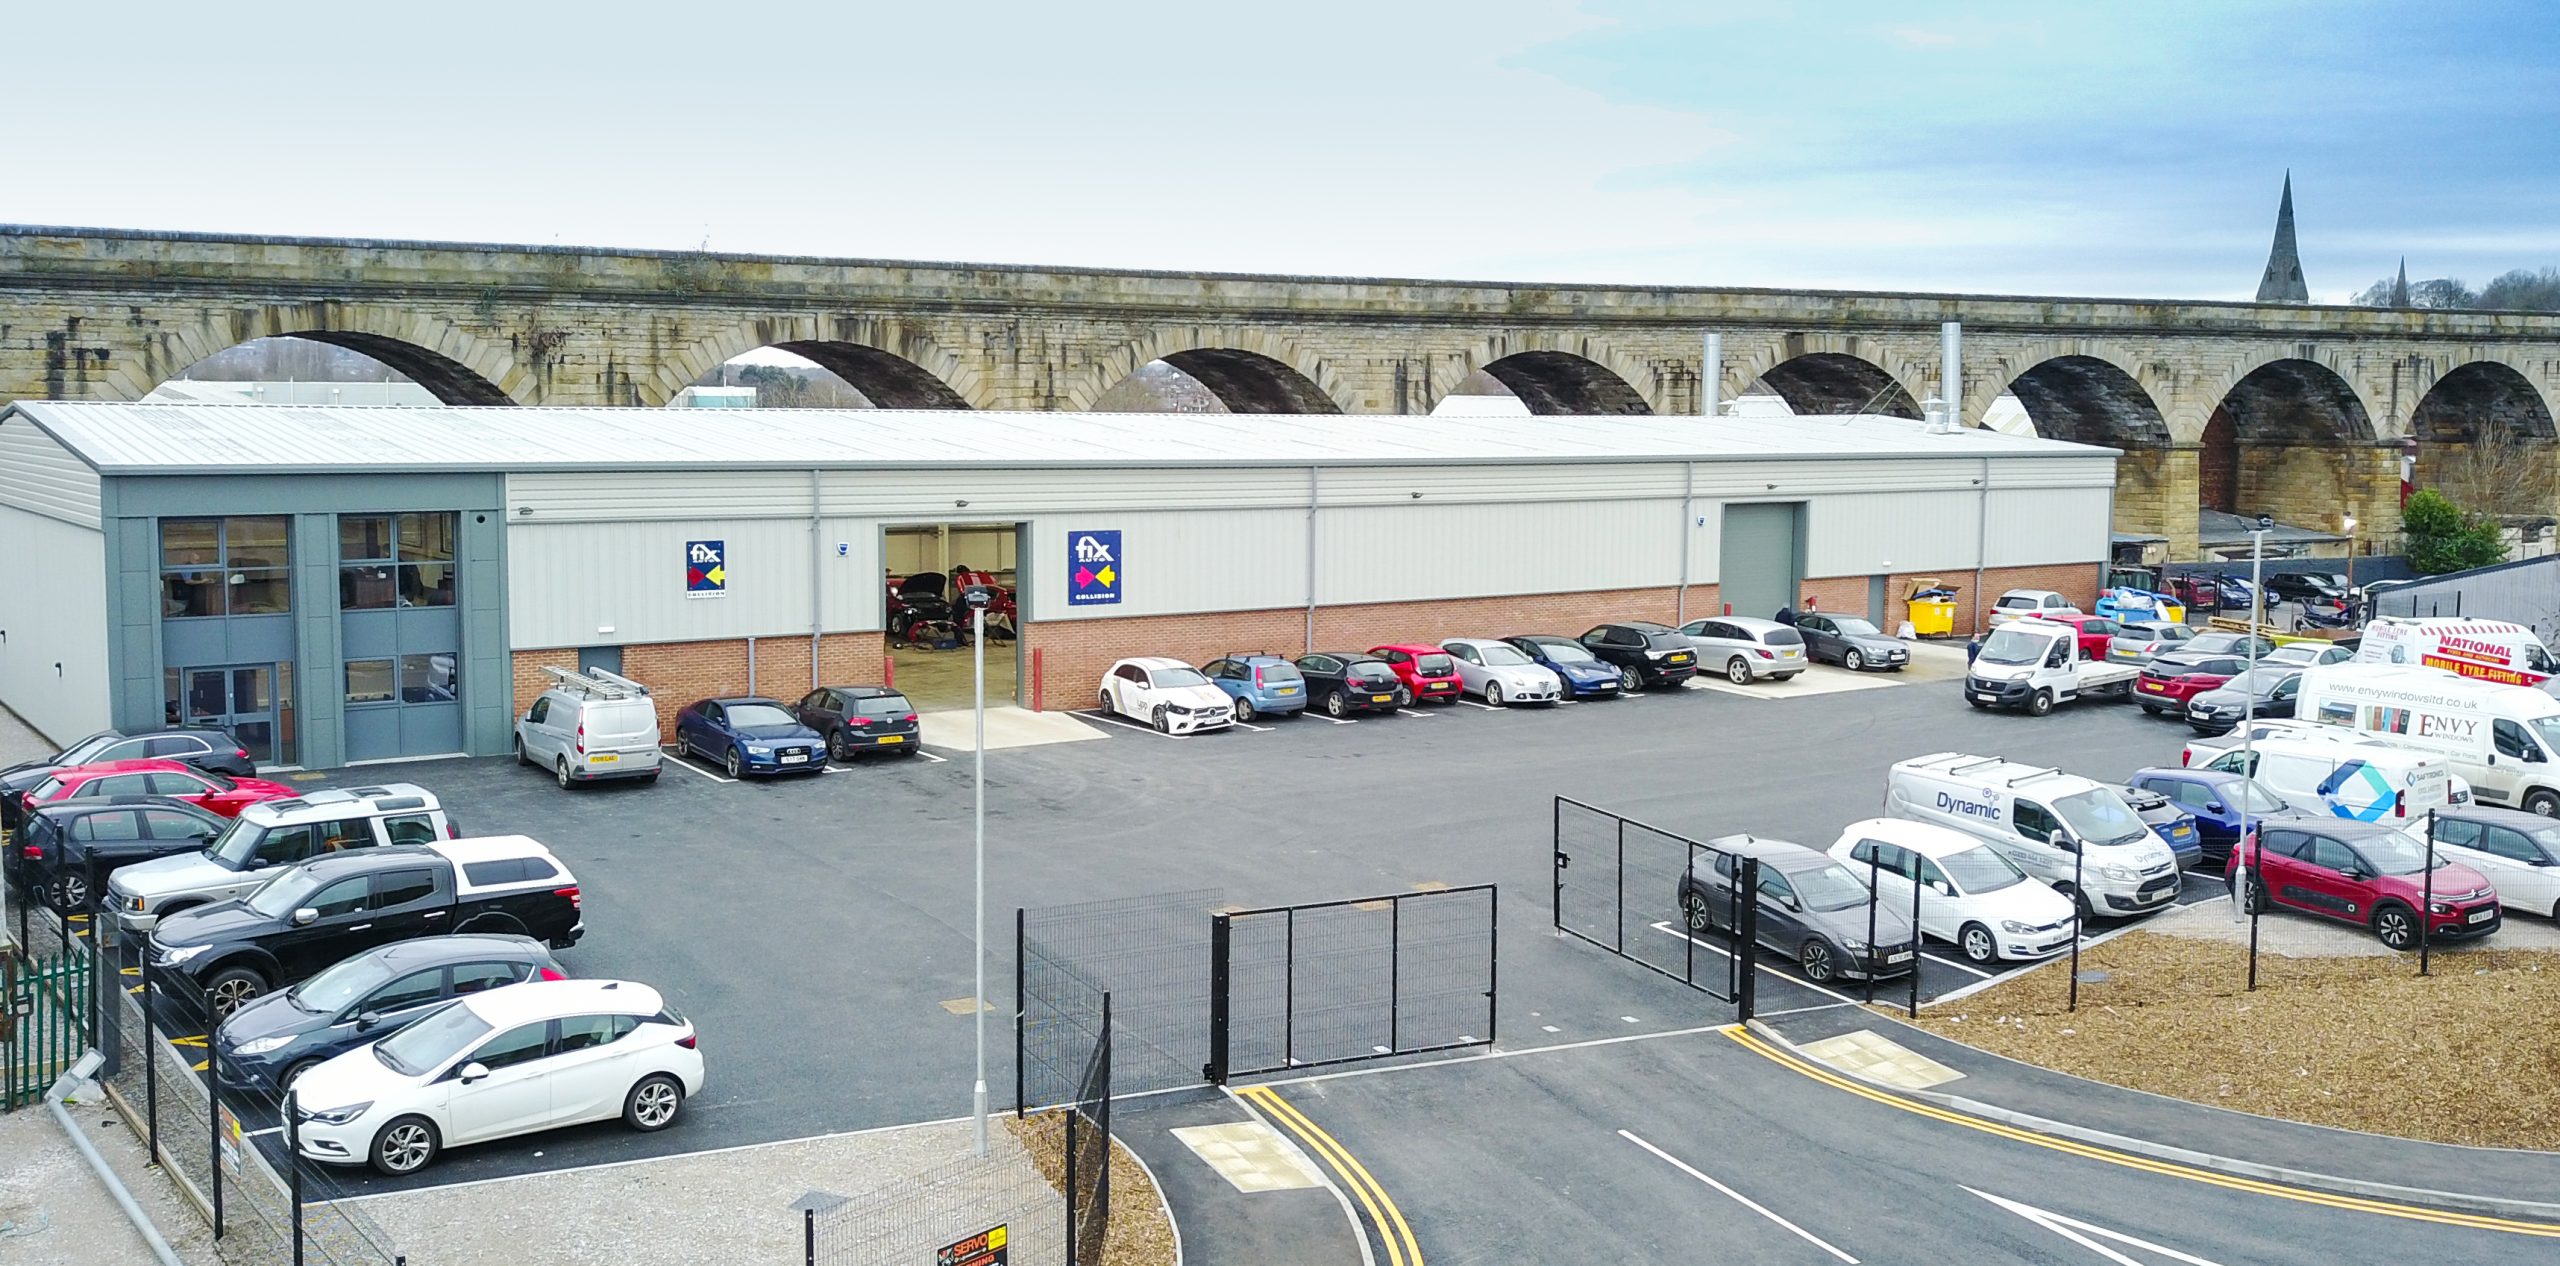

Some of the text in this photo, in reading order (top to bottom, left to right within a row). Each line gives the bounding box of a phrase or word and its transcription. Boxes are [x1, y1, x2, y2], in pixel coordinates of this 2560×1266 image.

[690, 544, 721, 562] fix
[1075, 536, 1115, 561] fix
[2440, 635, 2512, 658] NATIONAL
[2425, 657, 2522, 685] MOBILE TYRE FITTING
[2329, 682, 2478, 710] www.envywindowsltd.co.uk
[2417, 713, 2479, 738] ENVY
[2434, 732, 2475, 743] WINDOWS
[1937, 791, 2001, 820] Dynamic
[954, 1233, 988, 1256] SERVO
